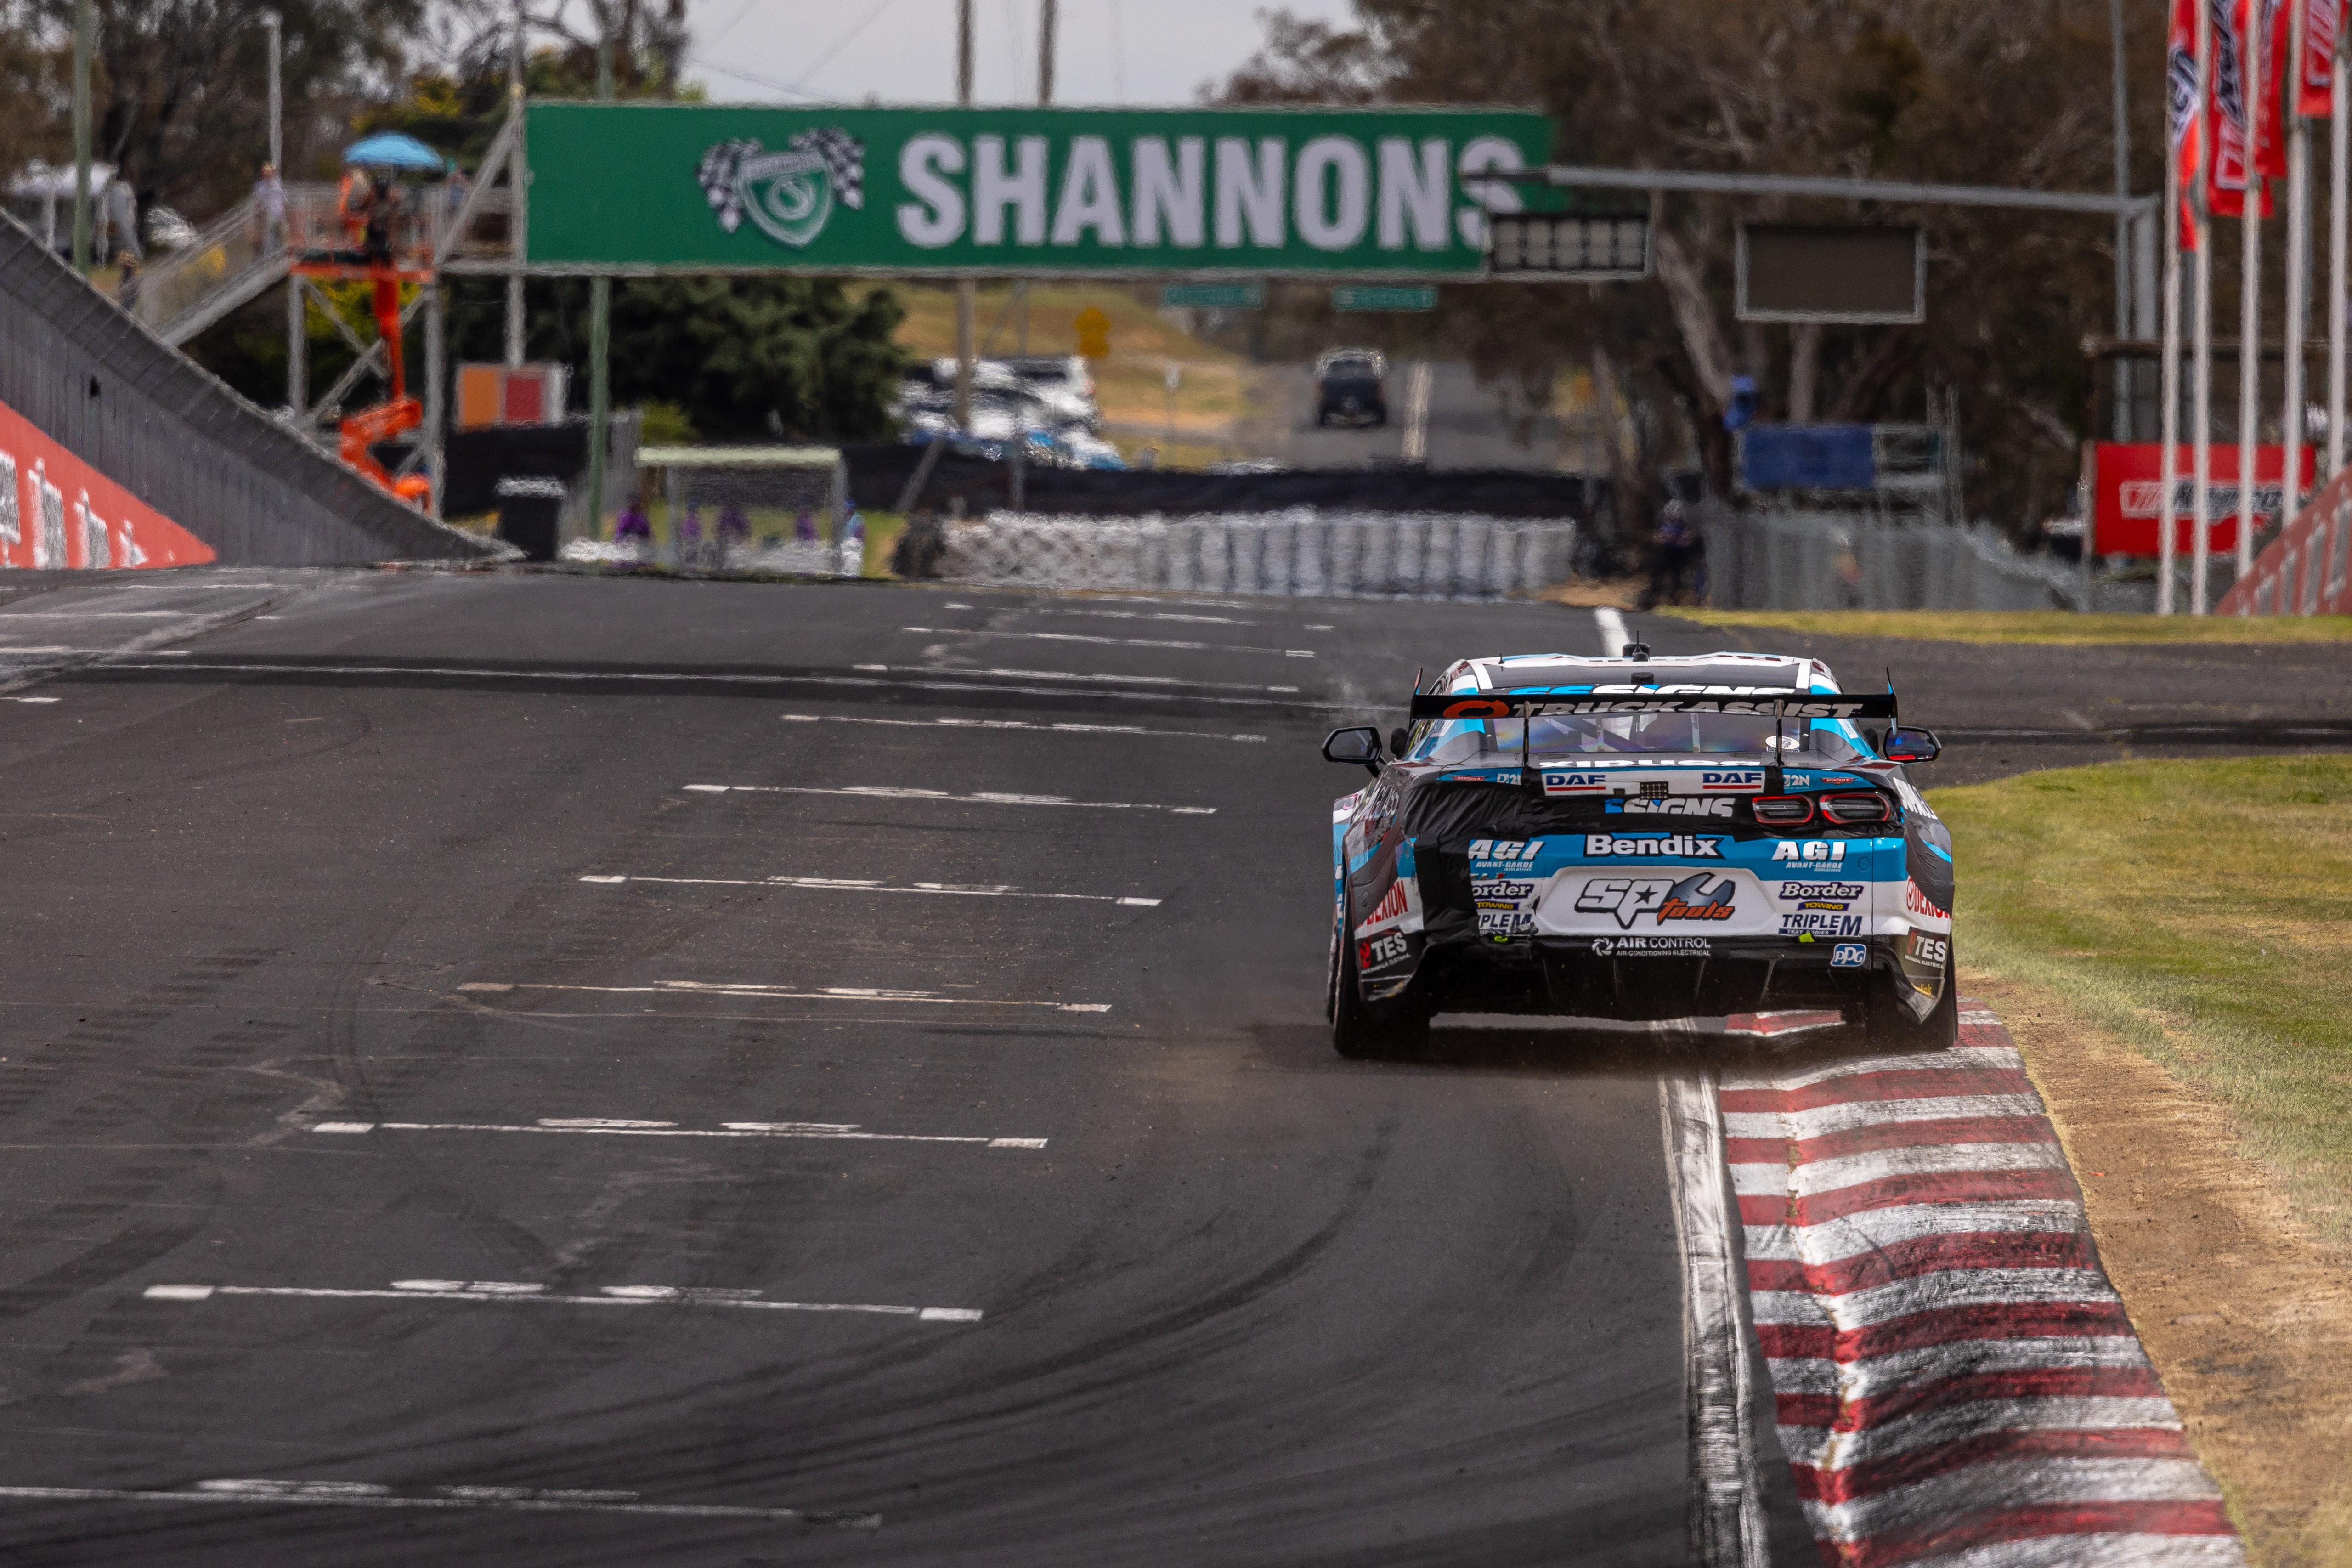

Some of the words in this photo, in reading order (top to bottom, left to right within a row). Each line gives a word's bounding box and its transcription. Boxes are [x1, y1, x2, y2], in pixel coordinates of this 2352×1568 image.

[896, 131, 1524, 254] SHANNONS
[1546, 774, 1606, 786] DAF
[1702, 772, 1762, 784] DAF
[1468, 840, 1544, 860] AGI
[1586, 834, 1719, 855] Bendix
[1771, 841, 1846, 860] AGI
[1471, 881, 1532, 897] order
[1781, 883, 1861, 897] Border
[1657, 897, 1735, 926] tools
[1804, 902, 1844, 910] TOWING
[1371, 932, 1407, 962] TES
[1616, 937, 1647, 948] AIR
[1649, 937, 1712, 949] CONTROL
[1915, 935, 1946, 962] TES
